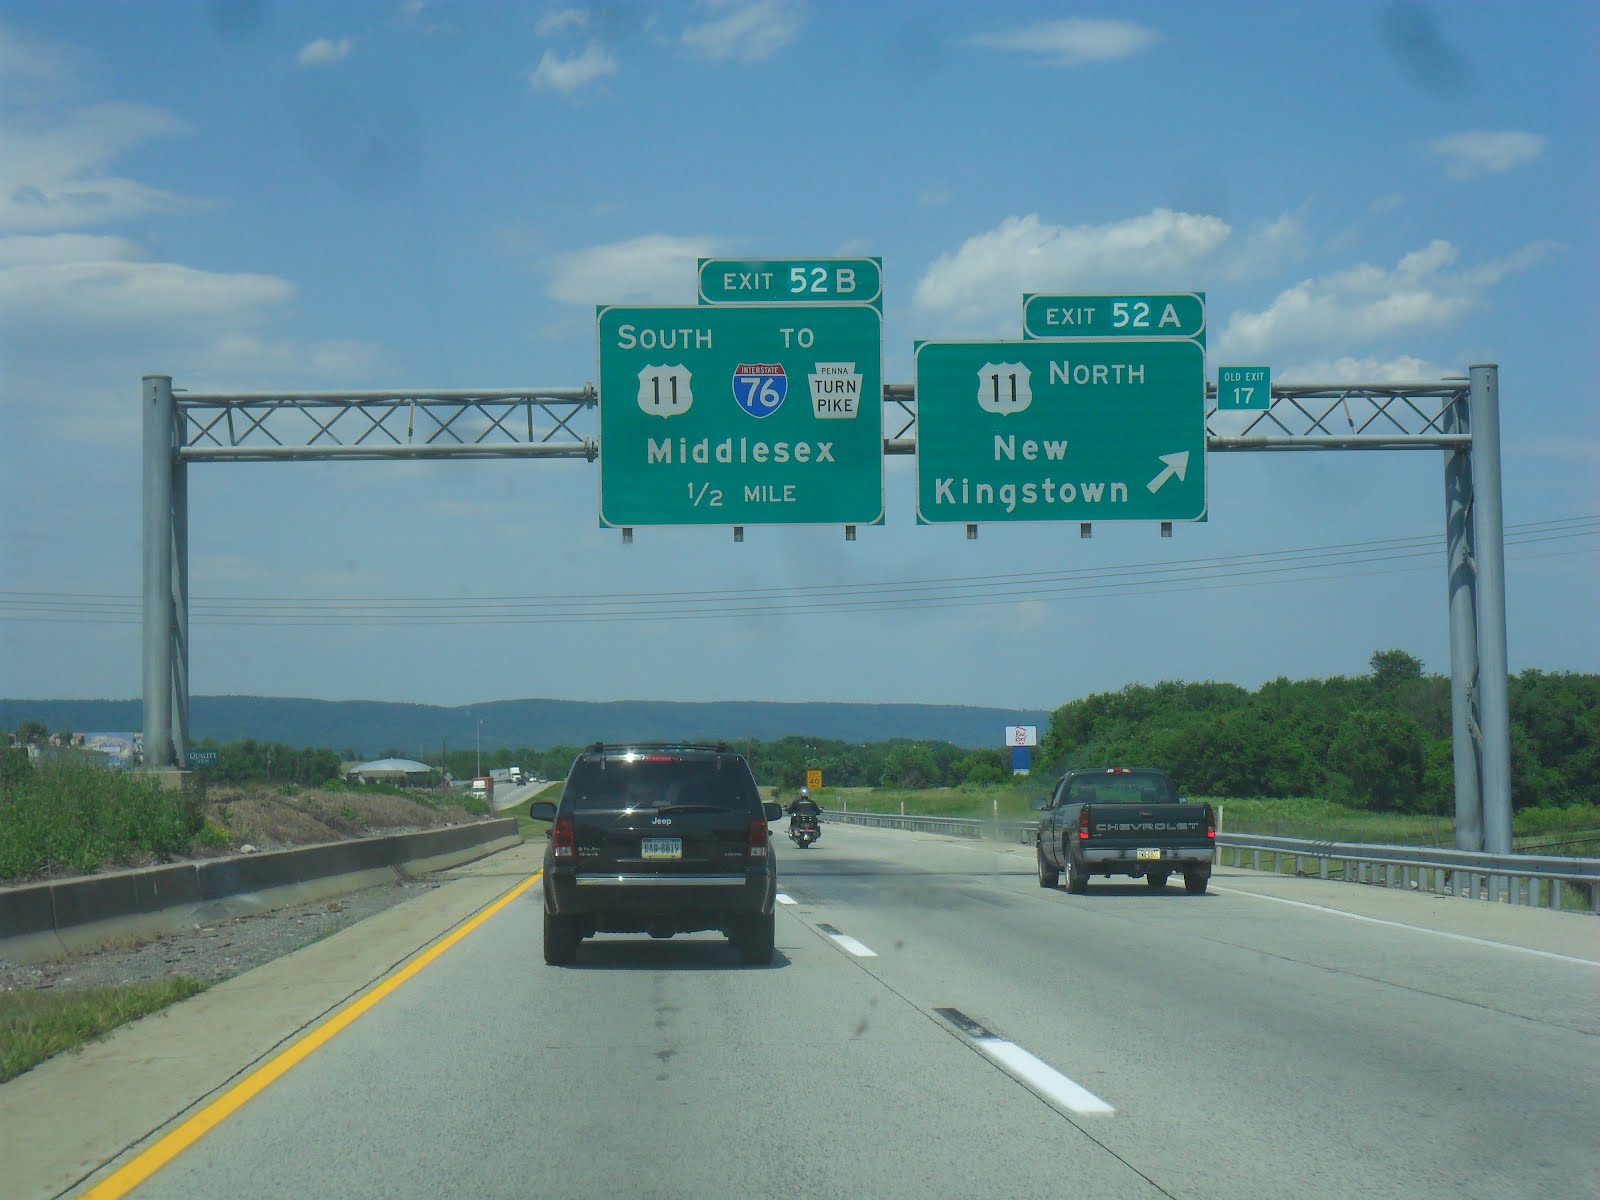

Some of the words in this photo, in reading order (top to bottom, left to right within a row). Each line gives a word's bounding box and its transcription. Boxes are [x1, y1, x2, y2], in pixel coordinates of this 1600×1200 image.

[723, 272, 774, 290] EXIT
[790, 267, 828, 293] 52
[836, 268, 856, 293] B
[1046, 308, 1096, 326] EXIT
[1112, 302, 1150, 328] 52
[1158, 303, 1182, 328] A
[617, 324, 712, 349] SOUTH
[780, 328, 815, 348] TO
[741, 366, 779, 375] INTERSTATE
[821, 367, 849, 376] PENNA
[1049, 360, 1146, 385] NORTH
[1224, 372, 1241, 382] OLD
[1245, 372, 1265, 382] EXIT
[651, 376, 678, 405] 11
[740, 378, 780, 407] 76
[814, 380, 857, 394] TURN
[990, 373, 1018, 403] 11
[1233, 387, 1255, 404] 17
[817, 399, 853, 412] PIKE
[647, 437, 836, 464] Middlesex
[994, 434, 1069, 461] New
[744, 485, 796, 502] MILE
[934, 478, 1129, 513] Kingstown
[651, 817, 672, 826] Jeep
[1095, 822, 1200, 831] CHEVROLET
